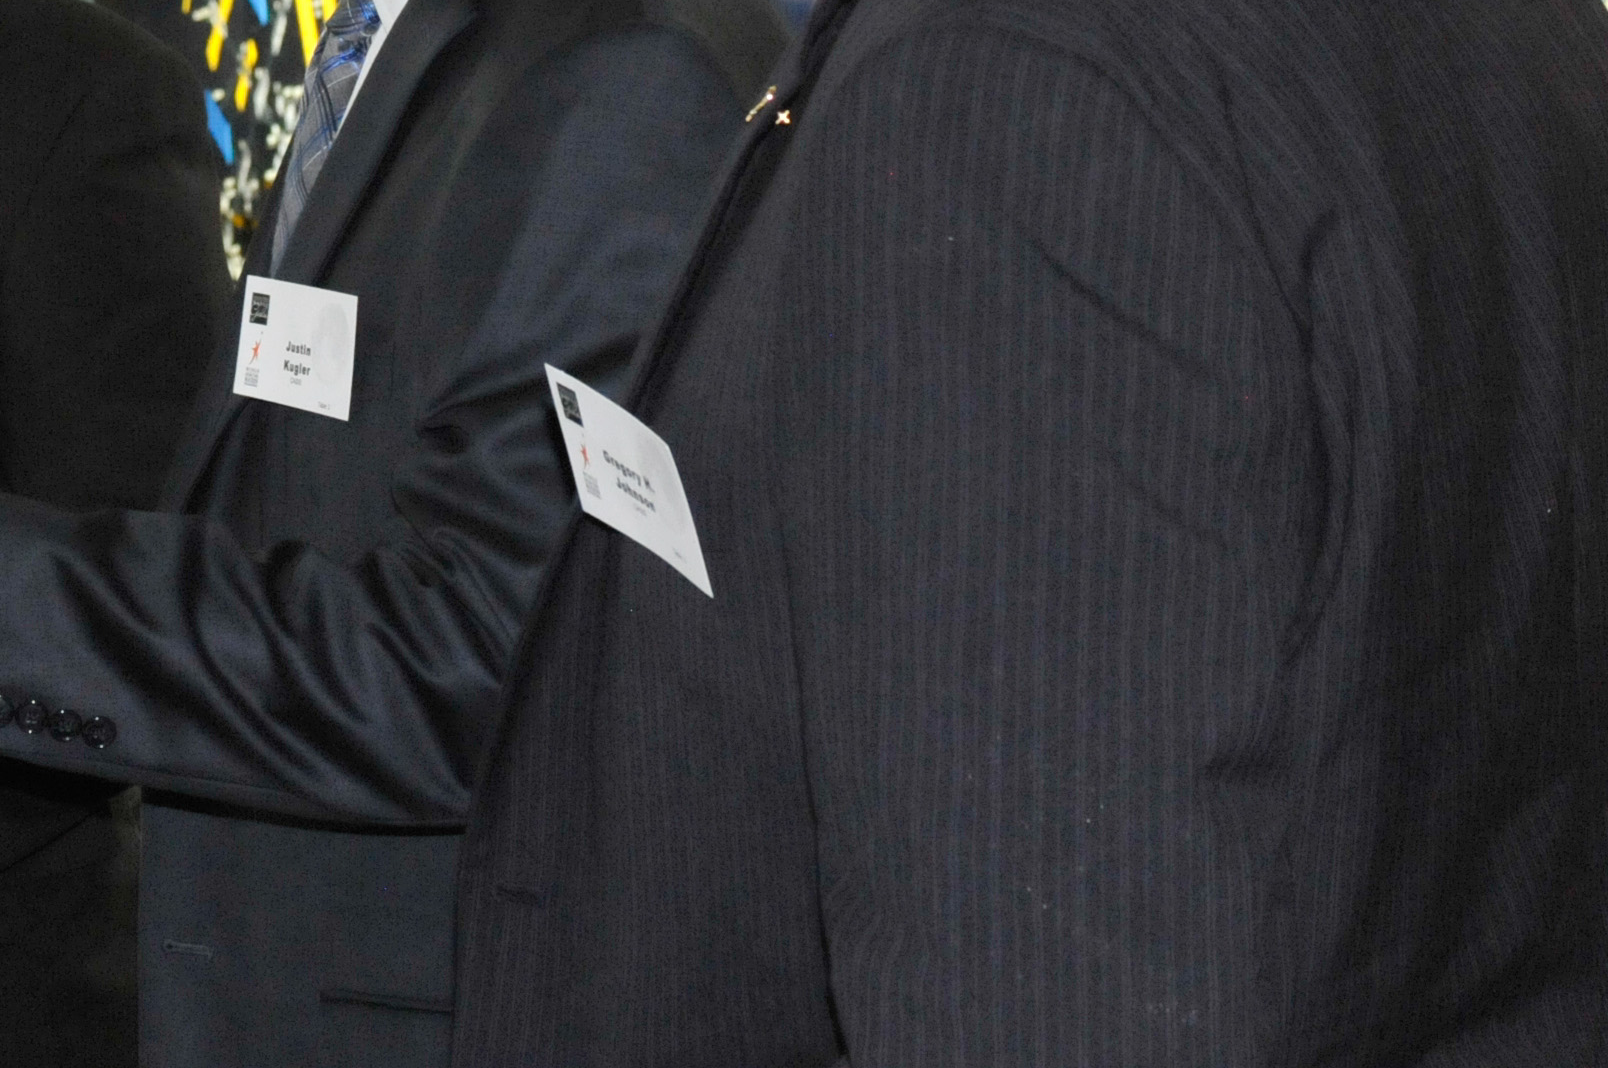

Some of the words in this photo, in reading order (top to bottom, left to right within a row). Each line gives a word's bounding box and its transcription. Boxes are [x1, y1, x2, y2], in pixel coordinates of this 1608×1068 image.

[286, 341, 312, 356] Justin
[283, 360, 311, 376] Kugler
[602, 449, 641, 487] Gregory
